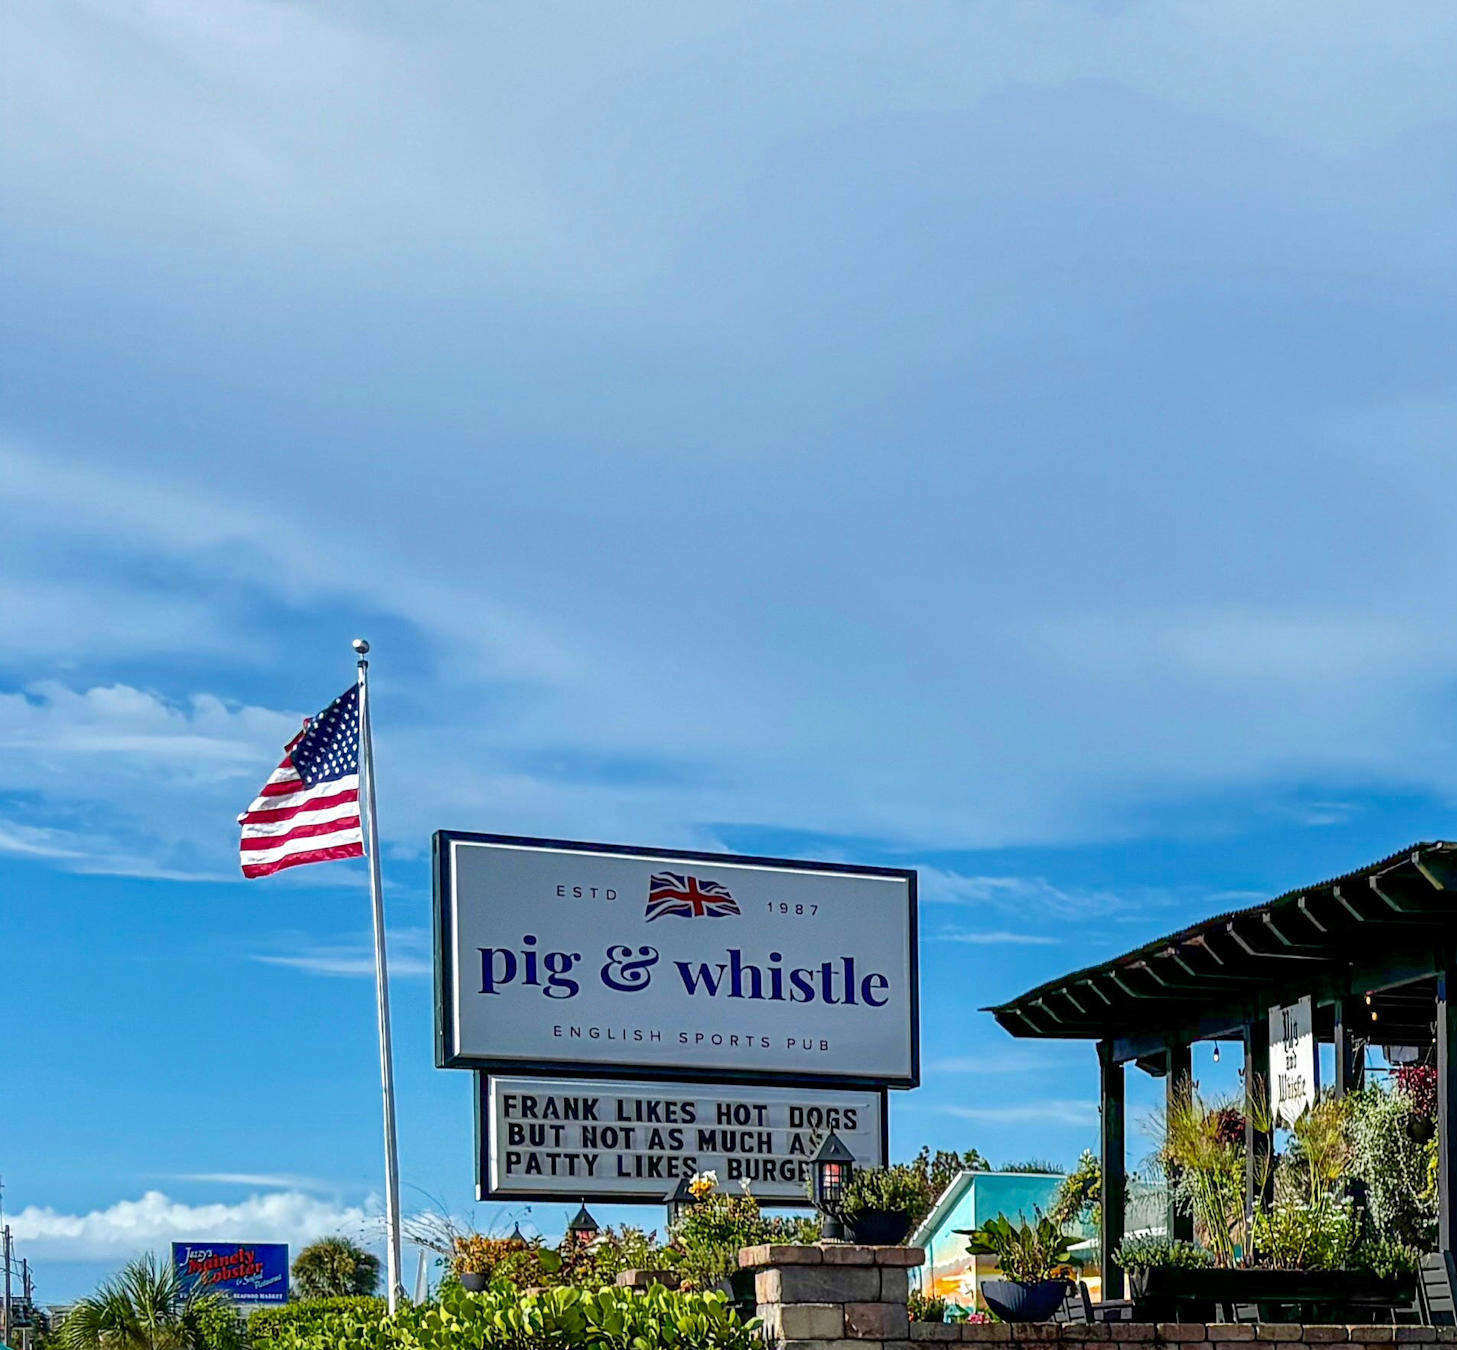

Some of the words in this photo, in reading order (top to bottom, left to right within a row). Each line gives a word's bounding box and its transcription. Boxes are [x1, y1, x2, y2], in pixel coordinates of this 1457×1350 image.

[556, 885, 618, 901] ESTD
[767, 901, 819, 917] 1987
[477, 935, 581, 999] pig
[600, 945, 659, 992] &
[674, 949, 889, 1007] whistle
[553, 1025, 662, 1043] ENGLISH
[679, 1031, 772, 1049] SPORTS
[787, 1038, 831, 1052] PUB
[503, 1095, 600, 1121] FRANK
[617, 1100, 697, 1125] LIKES
[716, 1104, 767, 1127] HOT
[790, 1106, 858, 1130] DOGS
[508, 1123, 565, 1147] BUT
[582, 1126, 635, 1150] NOT
[648, 1129, 684, 1152] AS
[698, 1130, 772, 1154] MUCH
[506, 1151, 598, 1177] PATTY
[617, 1154, 697, 1179] LIKES
[727, 1158, 812, 1182] BURGE
